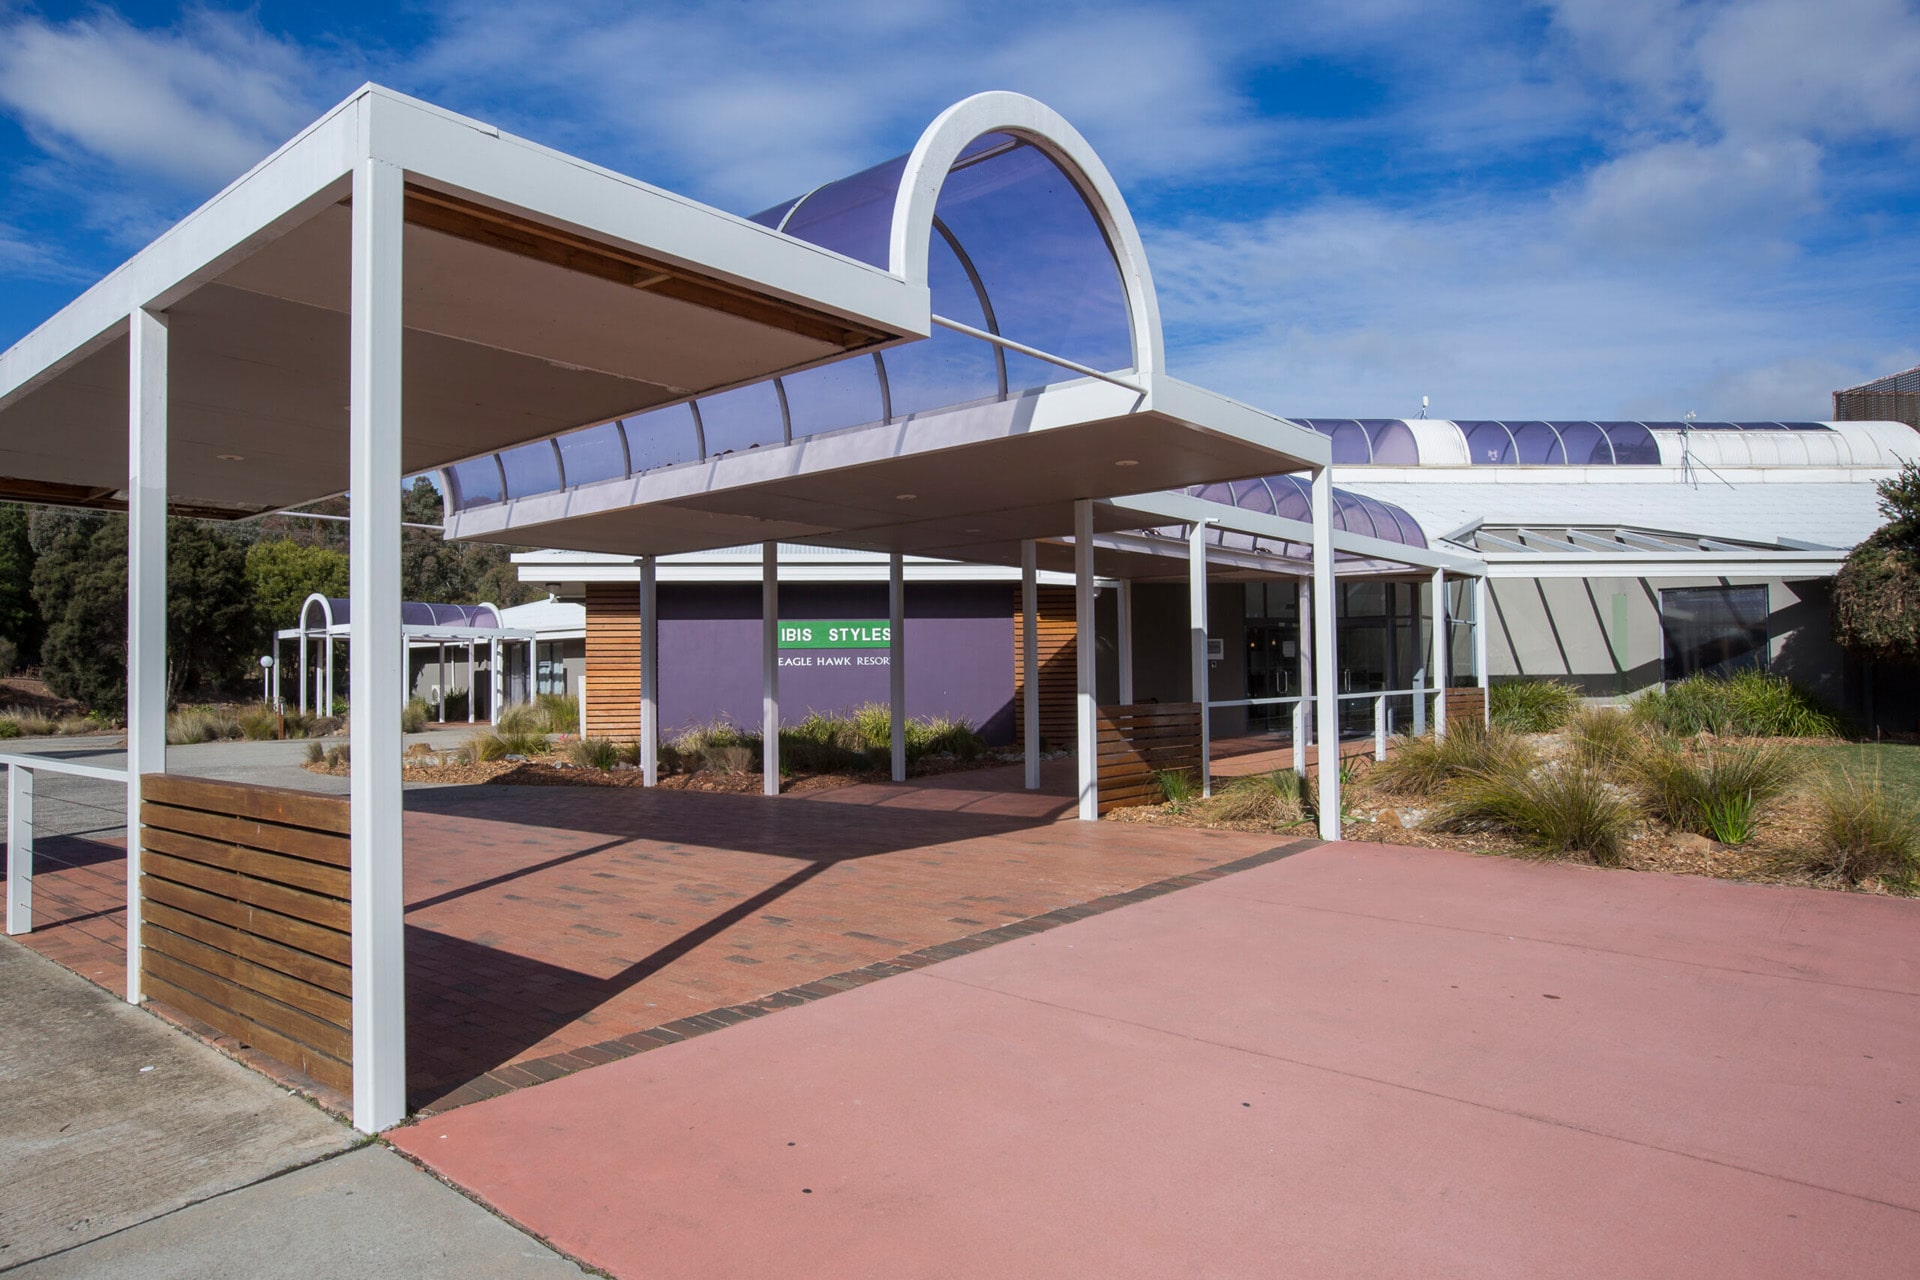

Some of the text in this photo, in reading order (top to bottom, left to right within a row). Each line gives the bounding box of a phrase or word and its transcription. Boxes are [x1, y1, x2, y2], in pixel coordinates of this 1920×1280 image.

[781, 627, 891, 642] IBIS STYLES
[778, 656, 891, 666] EAGLE HAWK RESOR
